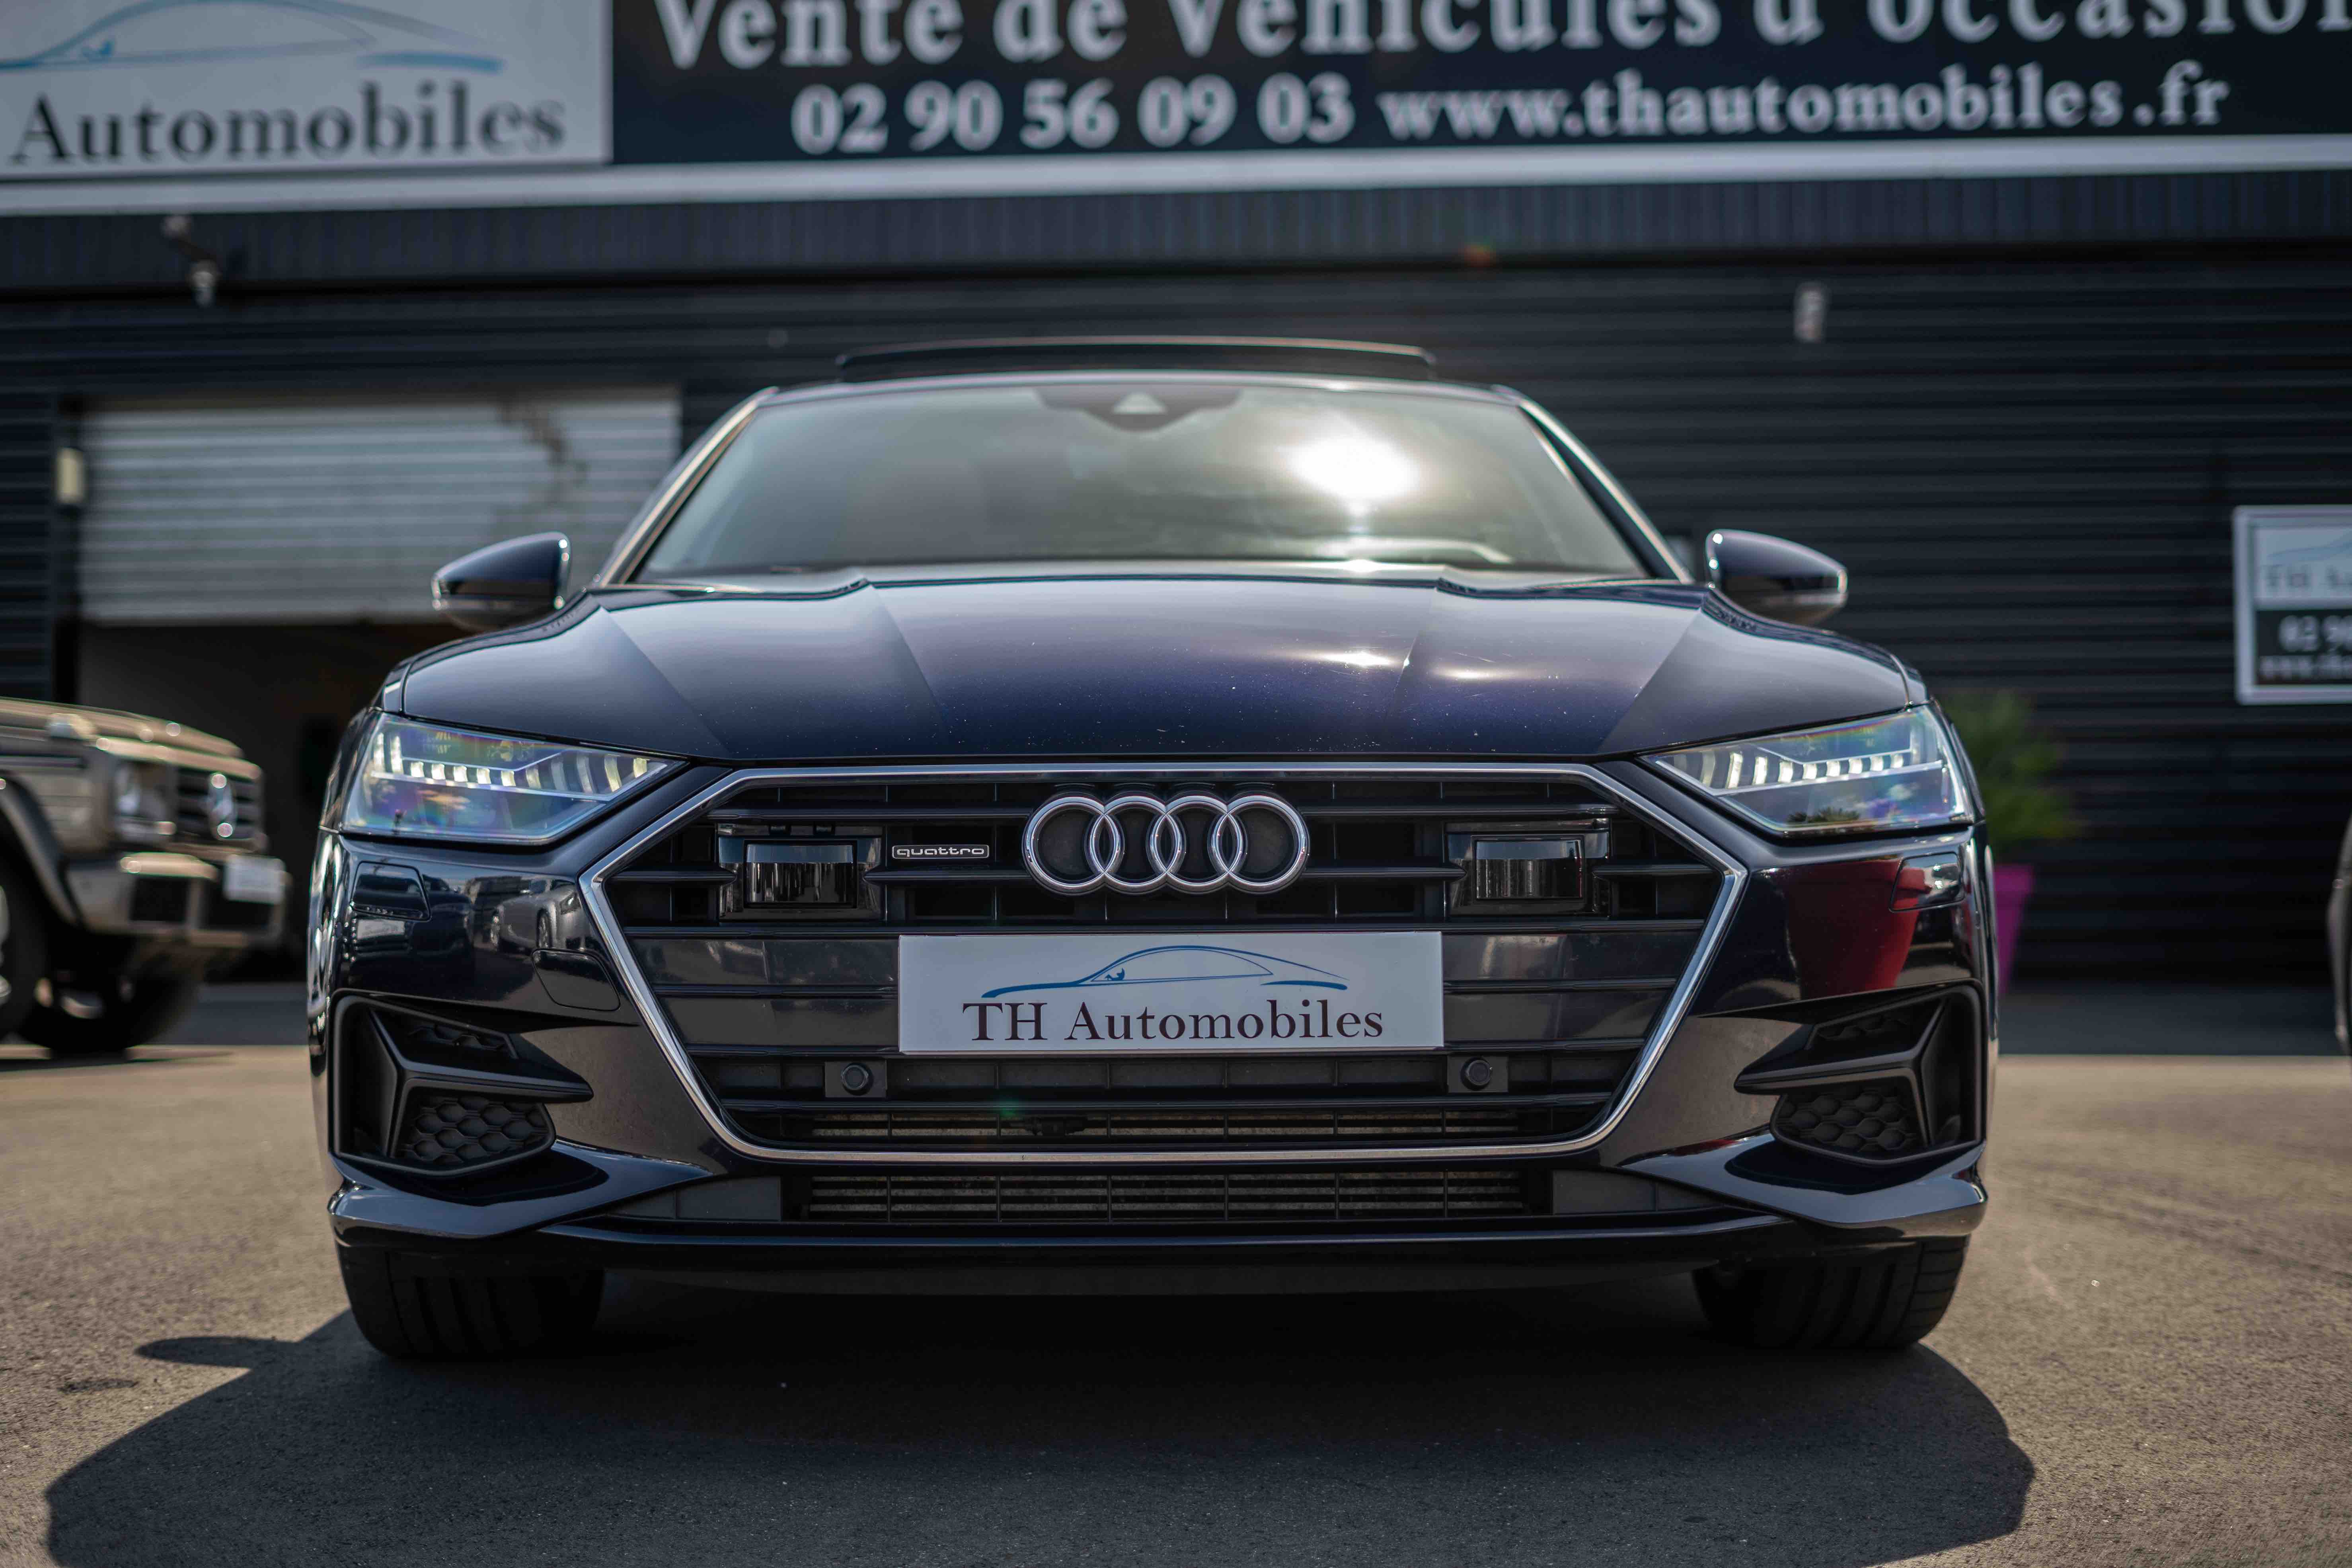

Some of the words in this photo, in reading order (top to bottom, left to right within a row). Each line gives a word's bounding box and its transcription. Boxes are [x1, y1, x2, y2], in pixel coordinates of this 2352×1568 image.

[655, 0, 963, 69] Vente
[993, 0, 1127, 63] de
[14, 80, 567, 162] Automobiles
[790, 84, 888, 154] 02
[903, 80, 1004, 152] 90
[1019, 78, 1119, 150] 56
[1137, 74, 1237, 148] 09
[1256, 72, 1355, 144] 03
[896, 847, 985, 857] quattro
[963, 1002, 1048, 1042] TH
[1064, 999, 1384, 1041] Automobiles
